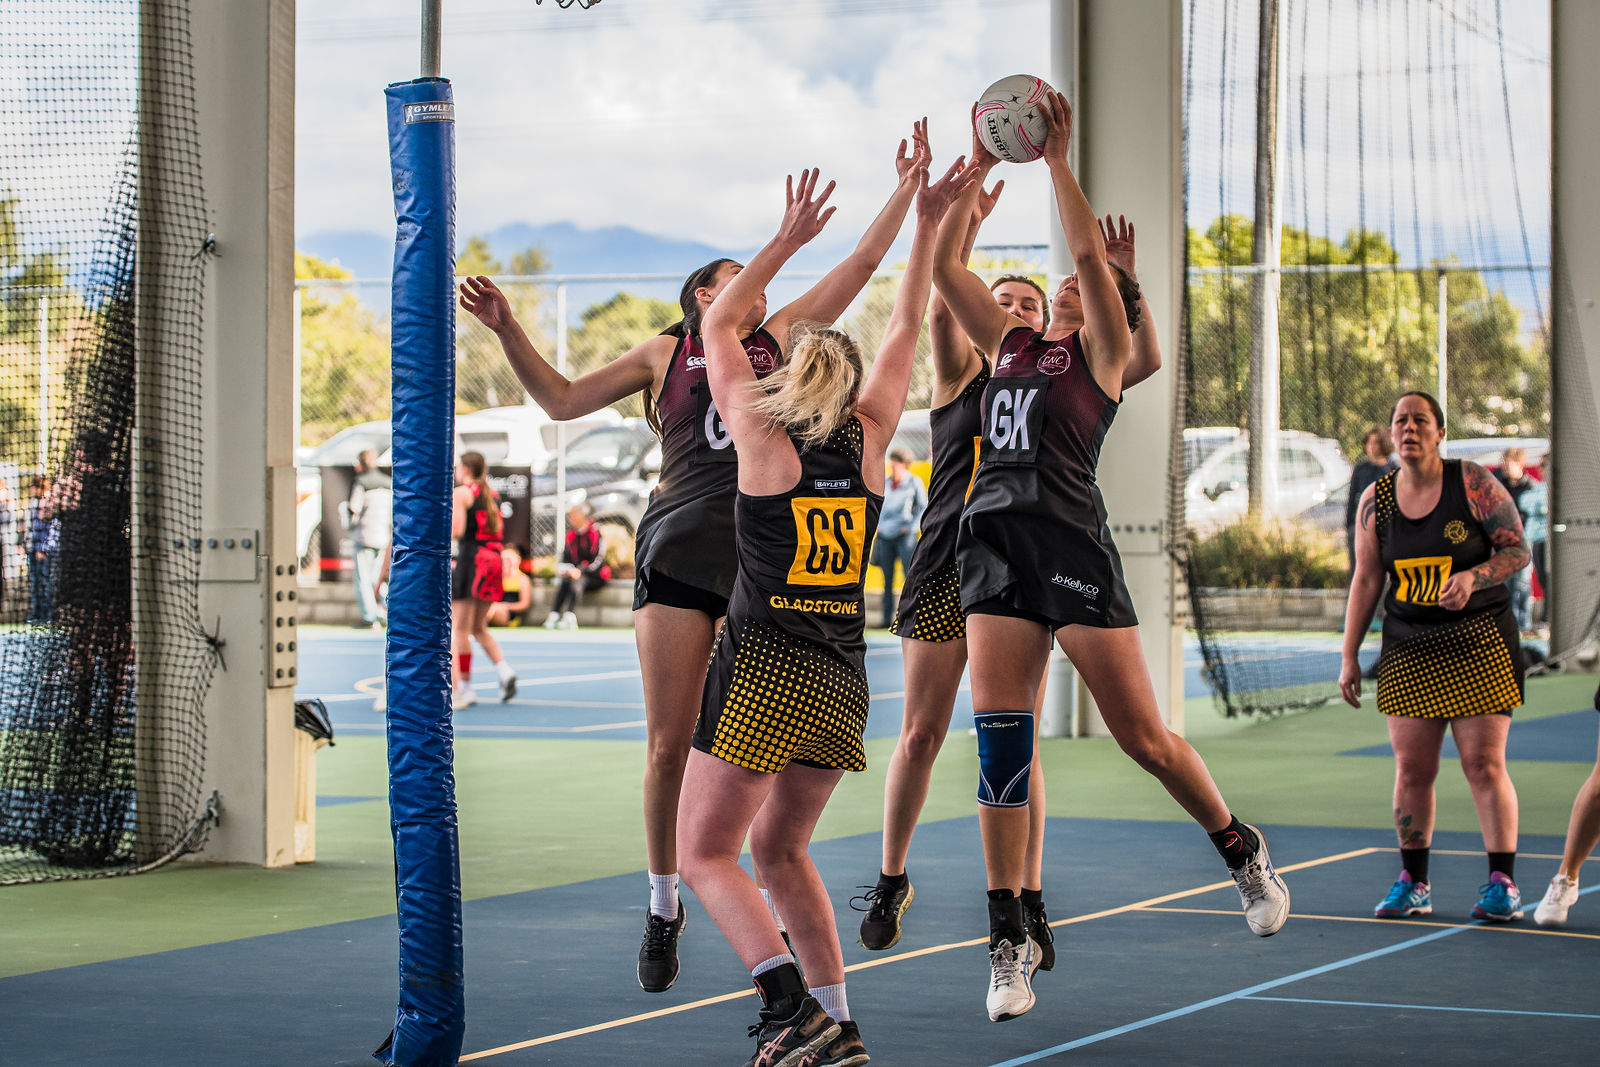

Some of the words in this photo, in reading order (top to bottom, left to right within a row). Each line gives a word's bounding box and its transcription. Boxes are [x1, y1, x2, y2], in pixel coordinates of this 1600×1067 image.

[987, 116, 1016, 160] ILBERT
[1042, 355, 1064, 365] CNC
[704, 400, 735, 450] G
[990, 389, 1038, 450] GK
[805, 508, 853, 574] GS
[770, 595, 858, 615] GLADSTONE
[980, 721, 1019, 729] ProSport
